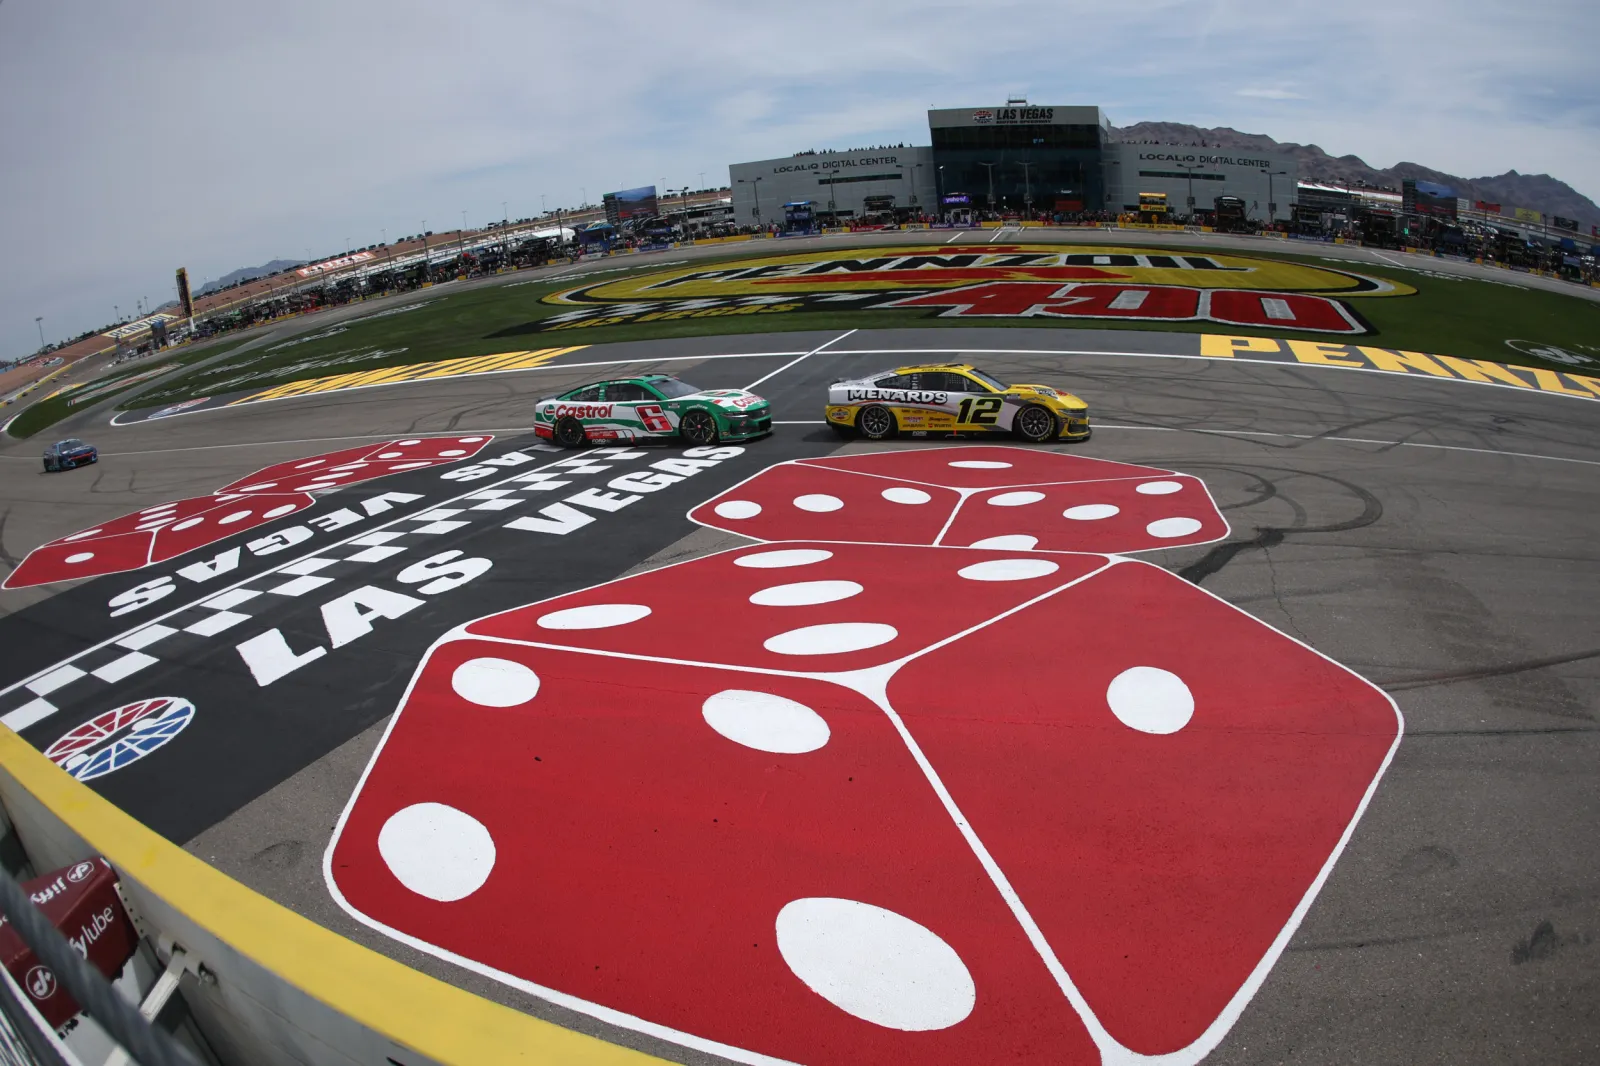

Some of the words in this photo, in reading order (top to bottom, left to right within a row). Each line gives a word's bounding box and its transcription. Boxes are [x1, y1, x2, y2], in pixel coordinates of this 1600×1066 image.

[996, 109, 1017, 120] LAS
[1019, 108, 1054, 119] VEGAS
[822, 159, 858, 169] DIGITAL
[859, 156, 898, 166] CENTER
[1199, 155, 1236, 165] DIGITAL
[1237, 158, 1271, 168] CENTER
[638, 254, 1256, 290] PENNZOIL
[632, 303, 805, 322] VEGAS
[887, 281, 1367, 334] 400
[848, 389, 948, 405] MENARDS
[955, 397, 1004, 425] 12
[555, 403, 614, 420] Castrol
[635, 404, 674, 433] 6
[440, 443, 566, 482] LAS
[108, 492, 426, 618] VEGAS
[236, 549, 493, 687] LAS
[503, 444, 746, 535] VEGAS
